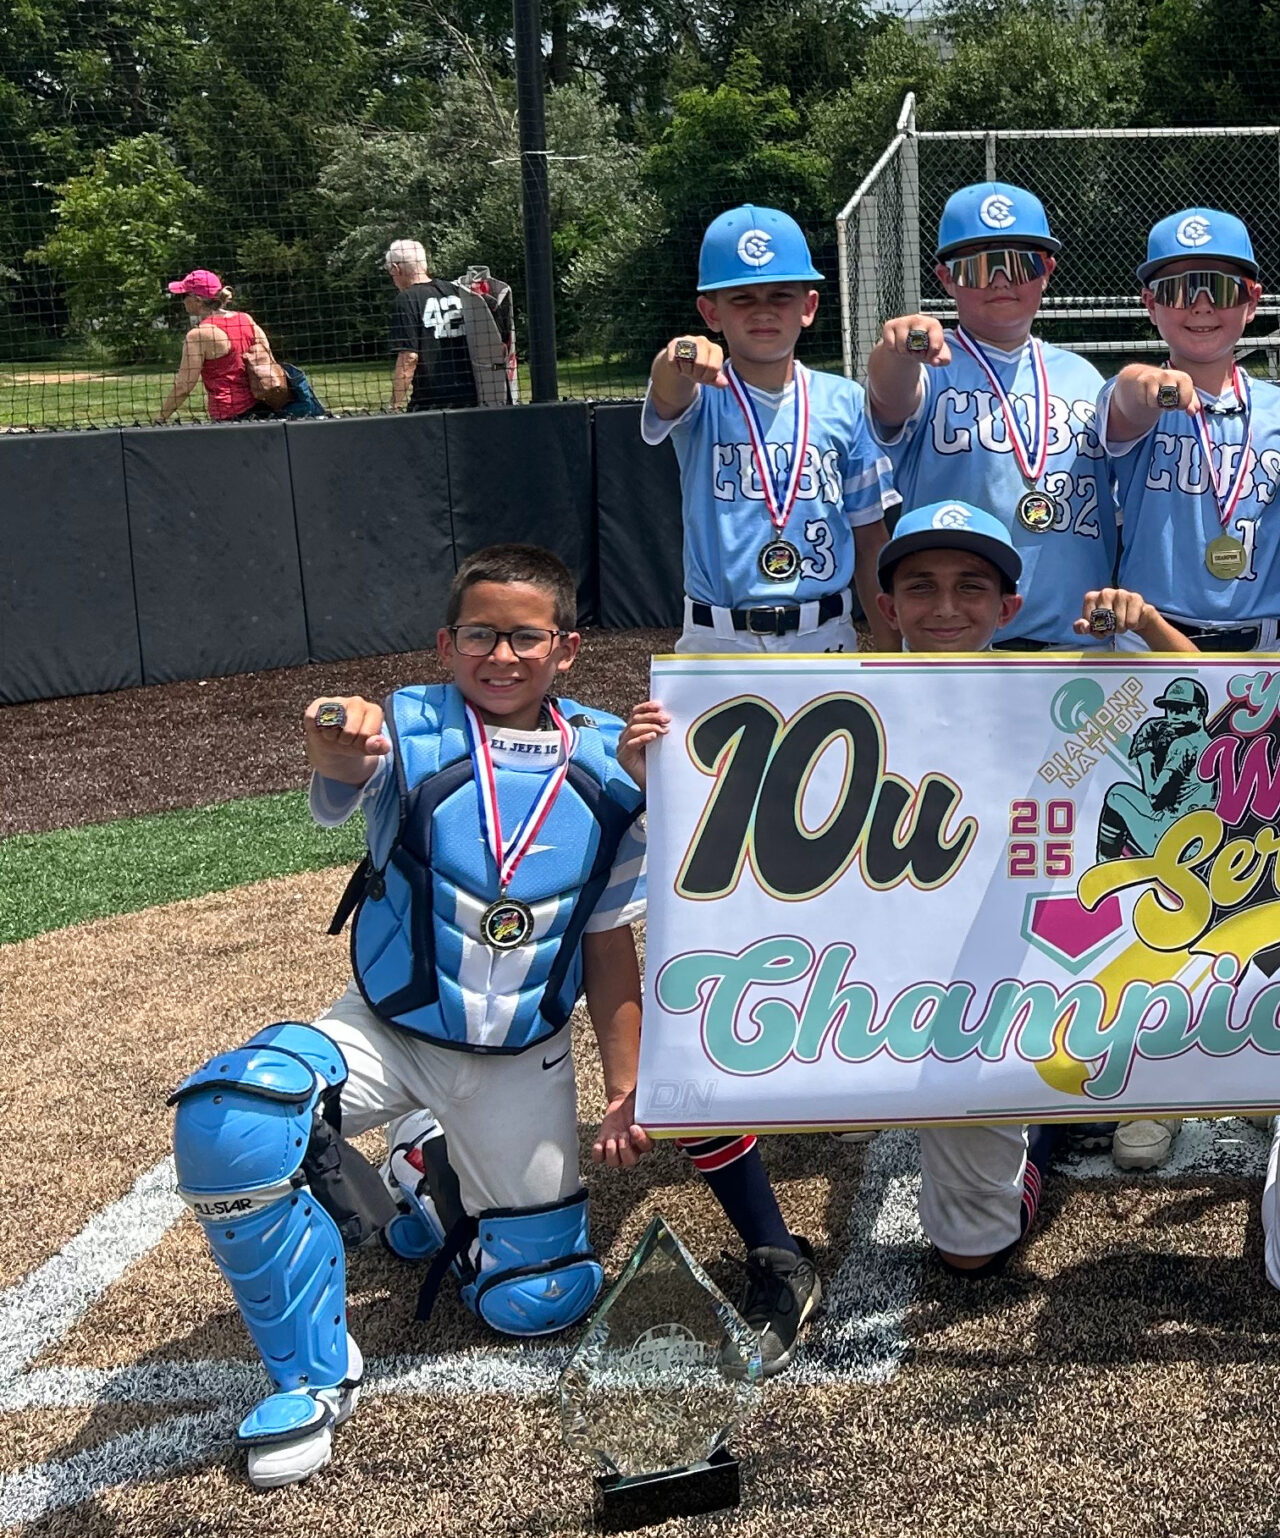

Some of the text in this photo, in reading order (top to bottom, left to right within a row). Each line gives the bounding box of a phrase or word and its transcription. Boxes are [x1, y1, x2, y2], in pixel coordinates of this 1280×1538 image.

[422, 295, 466, 339] 42
[930, 387, 1104, 459] CUBS
[713, 442, 844, 505] CUBS
[1044, 470, 1100, 539] 32
[800, 519, 837, 582] 3
[491, 739, 507, 750] EL
[509, 742, 542, 754] JEFE
[1038, 676, 1143, 784] DIAMOND
[1058, 696, 1149, 790] NATION
[674, 691, 978, 902] 10u
[1009, 798, 1076, 837] 20
[1008, 840, 1075, 878] 25
[647, 1079, 718, 1110] DN
